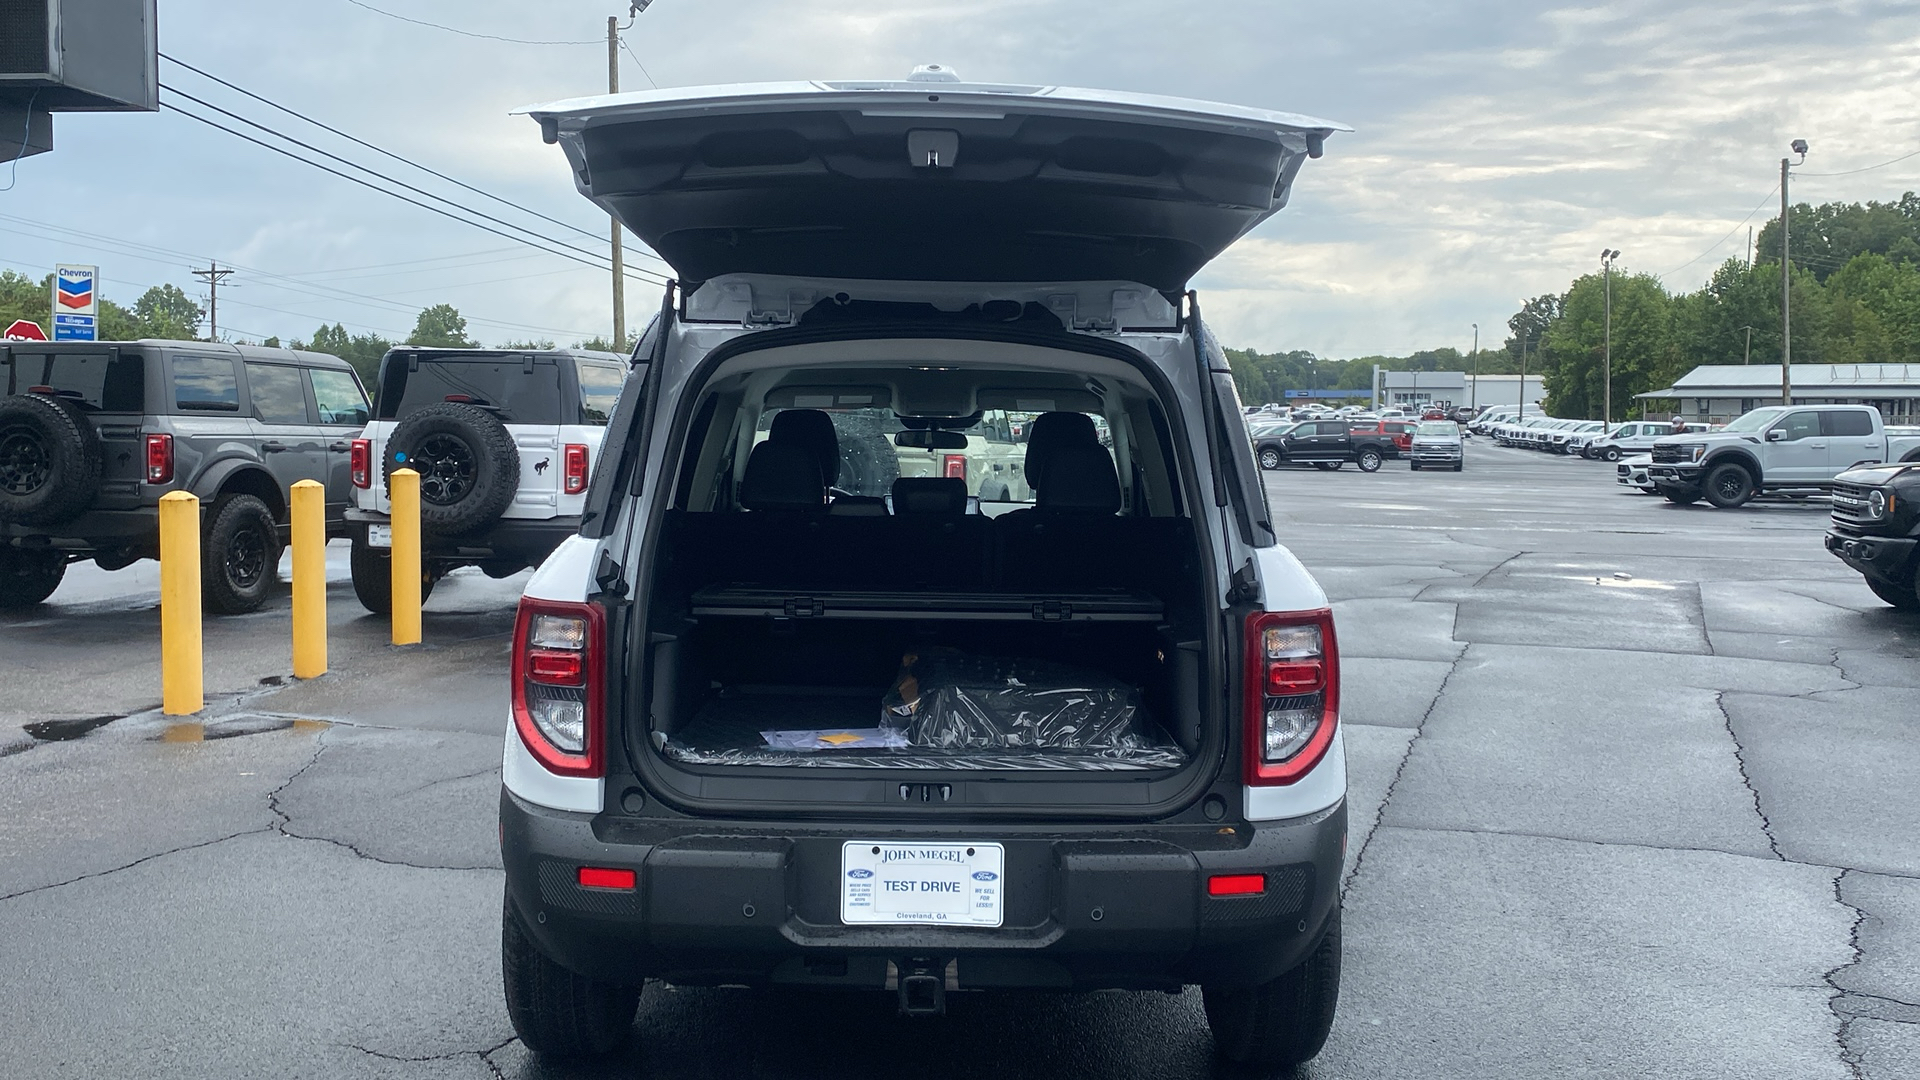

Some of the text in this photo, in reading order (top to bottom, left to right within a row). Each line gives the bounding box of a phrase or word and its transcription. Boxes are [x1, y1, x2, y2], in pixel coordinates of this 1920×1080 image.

[59, 268, 93, 277] Chevron
[882, 849, 964, 863] JOHN MEGEL
[851, 870, 870, 878] Ford
[975, 872, 995, 881] Ford
[884, 880, 961, 893] TEST DRIVE
[896, 912, 934, 920] Cleveland,
